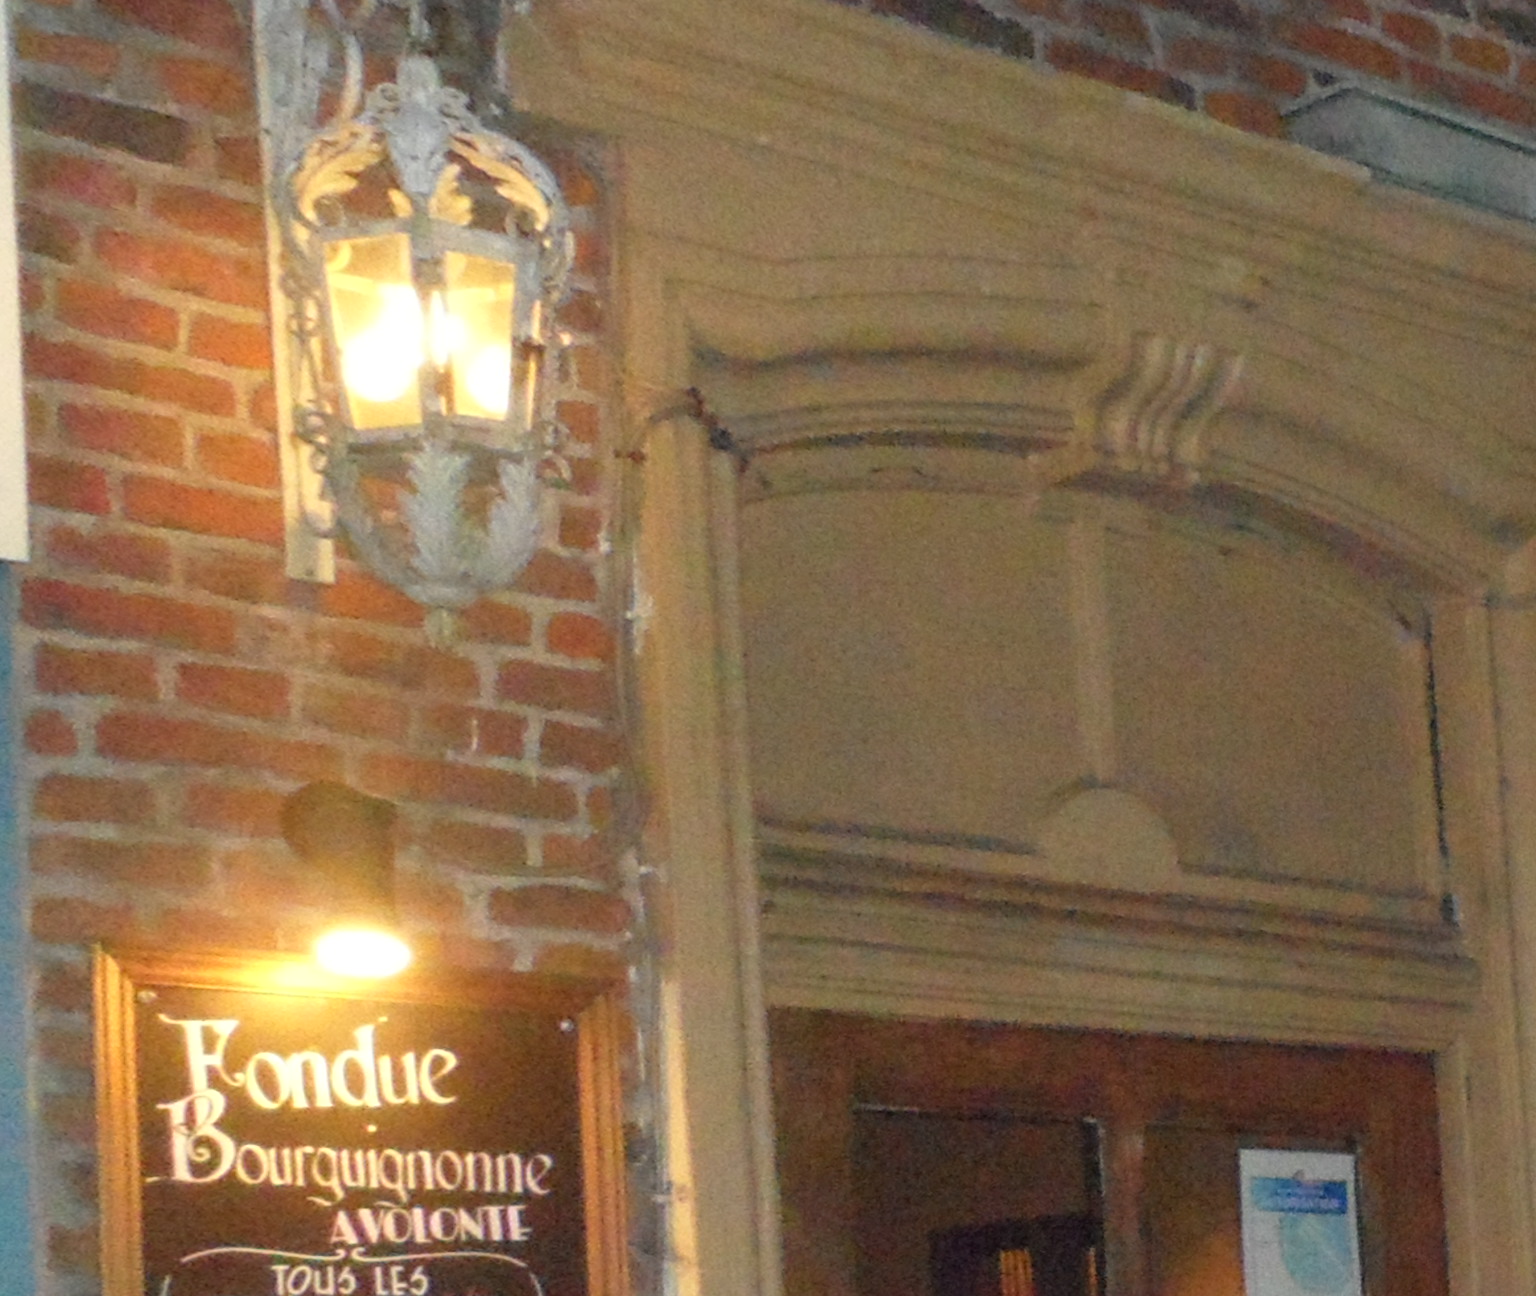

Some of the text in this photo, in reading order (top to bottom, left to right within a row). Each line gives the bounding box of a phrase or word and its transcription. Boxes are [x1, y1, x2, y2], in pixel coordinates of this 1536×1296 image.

[158, 1013, 459, 1110] Fondue
[150, 1088, 554, 1204] Bourguignonne
[272, 1264, 430, 1296] TOUS LES
